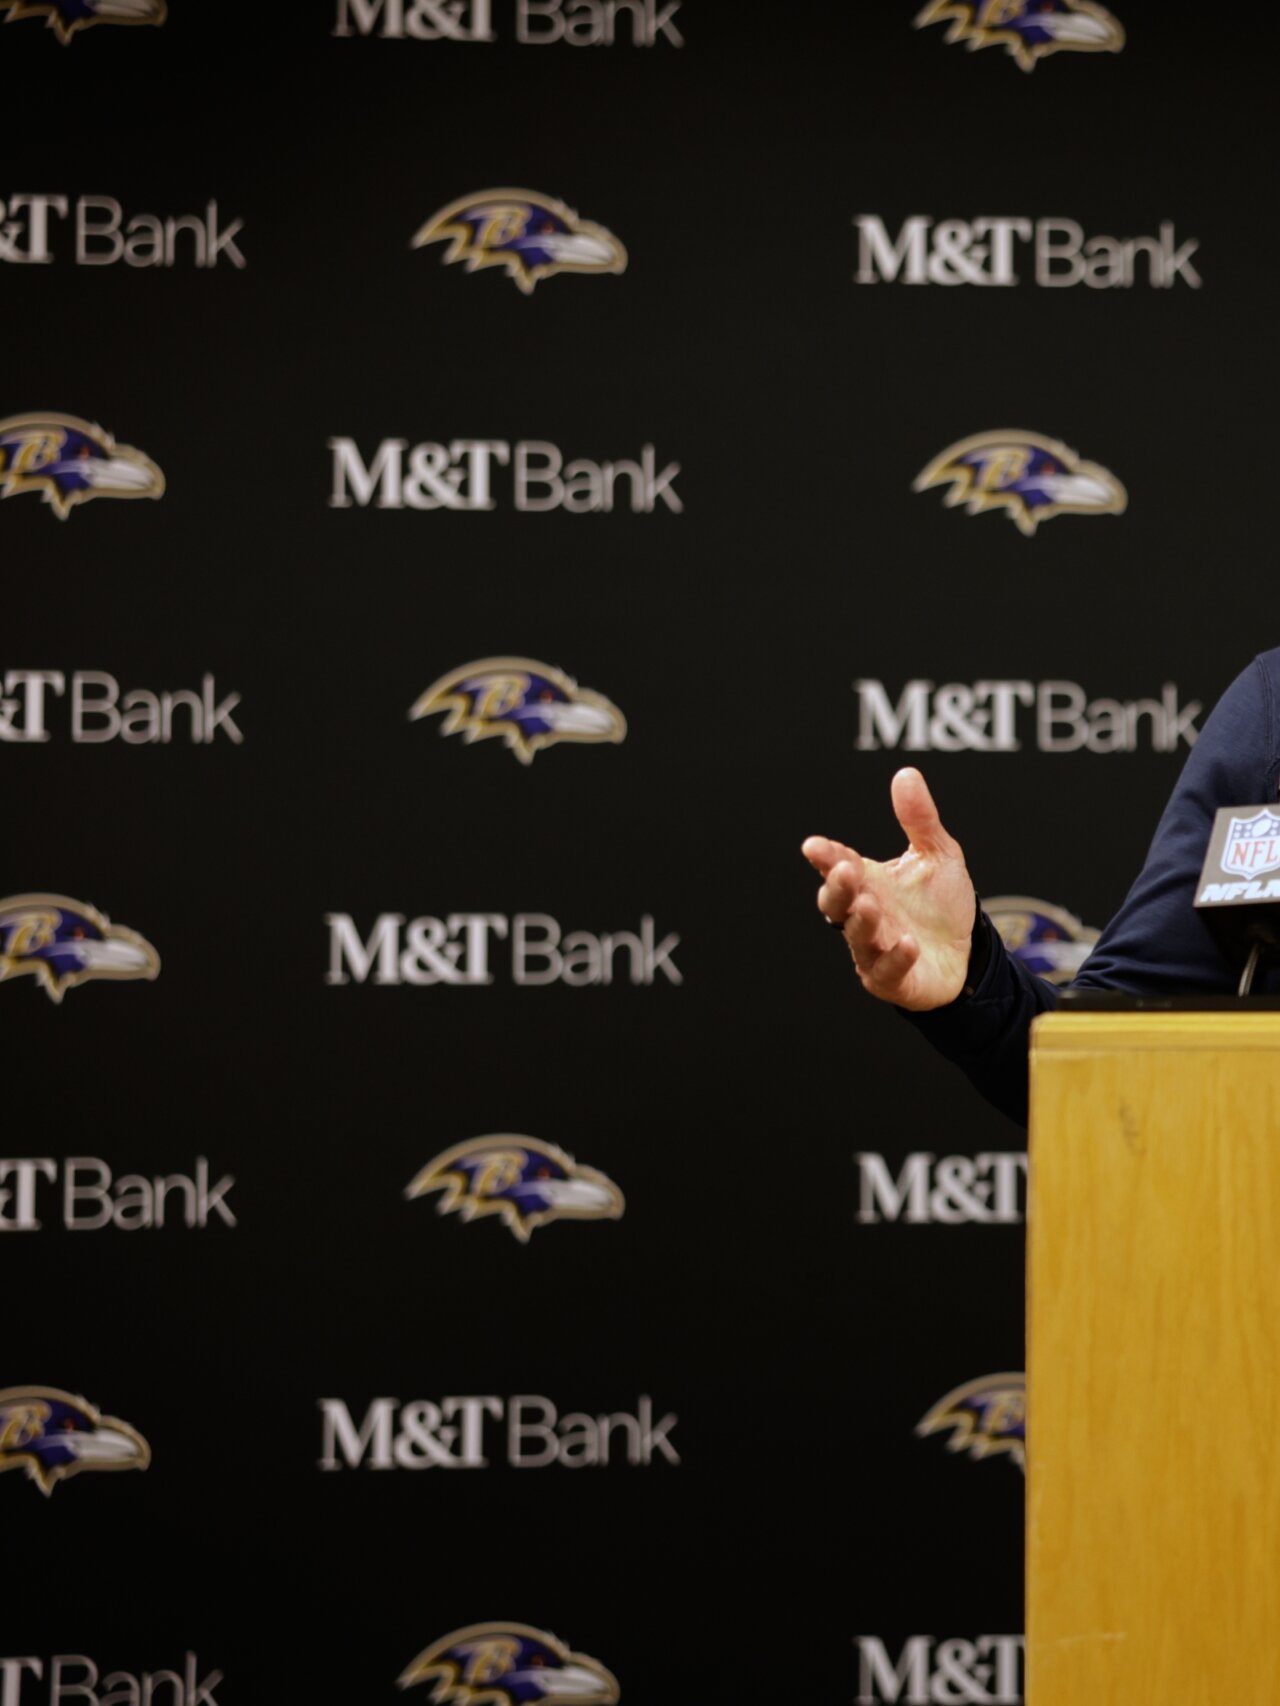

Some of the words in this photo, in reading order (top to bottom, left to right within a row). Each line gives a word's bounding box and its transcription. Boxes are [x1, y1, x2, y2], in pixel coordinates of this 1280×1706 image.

[516, 0, 683, 46] Bank
[77, 199, 243, 266] Bank
[857, 215, 1032, 286] M&T
[1036, 219, 1200, 288] Bank
[331, 438, 510, 510] M&T
[515, 442, 682, 512] Bank
[72, 672, 241, 743] Bank
[857, 679, 1034, 752] M&T
[1037, 680, 1202, 753] Bank
[1231, 840, 1279, 867] NFL
[328, 913, 508, 985] M&T
[513, 914, 681, 985] Bank
[65, 1158, 235, 1229] Bank
[859, 1153, 1024, 1223] M&T
[322, 1397, 503, 1469] M&T
[510, 1396, 677, 1466] Bank
[52, 1657, 215, 1706] Bank
[860, 1636, 1022, 1706] M&T
